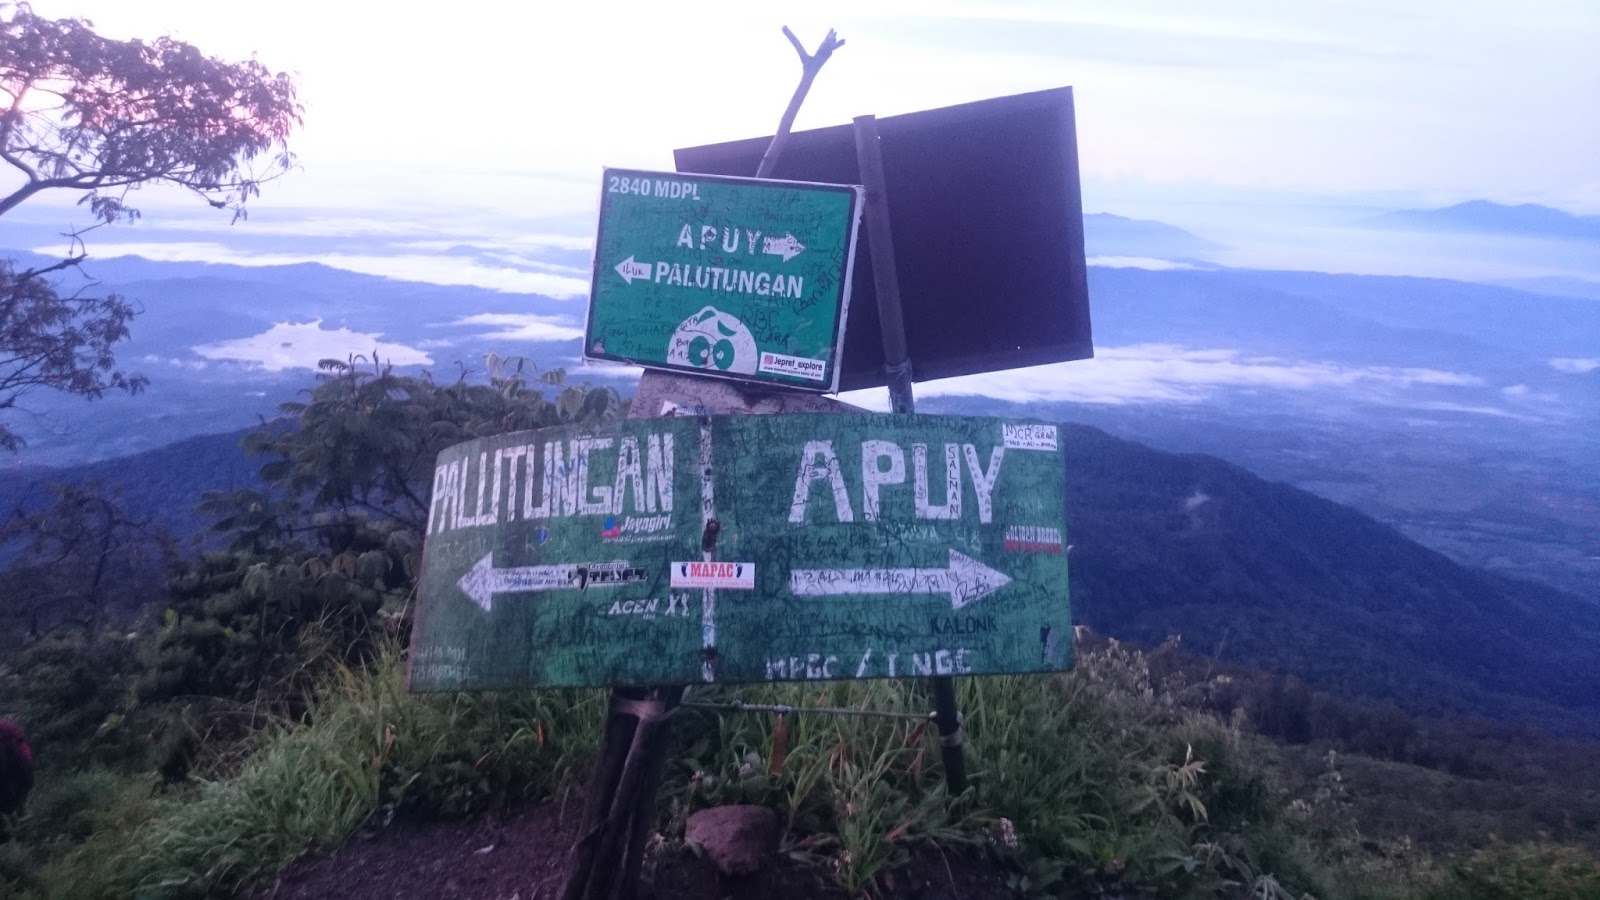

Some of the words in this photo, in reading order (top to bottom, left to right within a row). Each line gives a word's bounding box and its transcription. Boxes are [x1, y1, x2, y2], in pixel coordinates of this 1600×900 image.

[609, 176, 651, 196] 2840
[654, 180, 701, 200] MDPL
[677, 223, 762, 255] APUY
[655, 261, 803, 298] PALUTUNGAN
[426, 432, 674, 536] PALUTUNGAN
[787, 439, 1005, 524] APUY
[620, 515, 671, 533] Jayagiri
[690, 563, 733, 577] MAPAC
